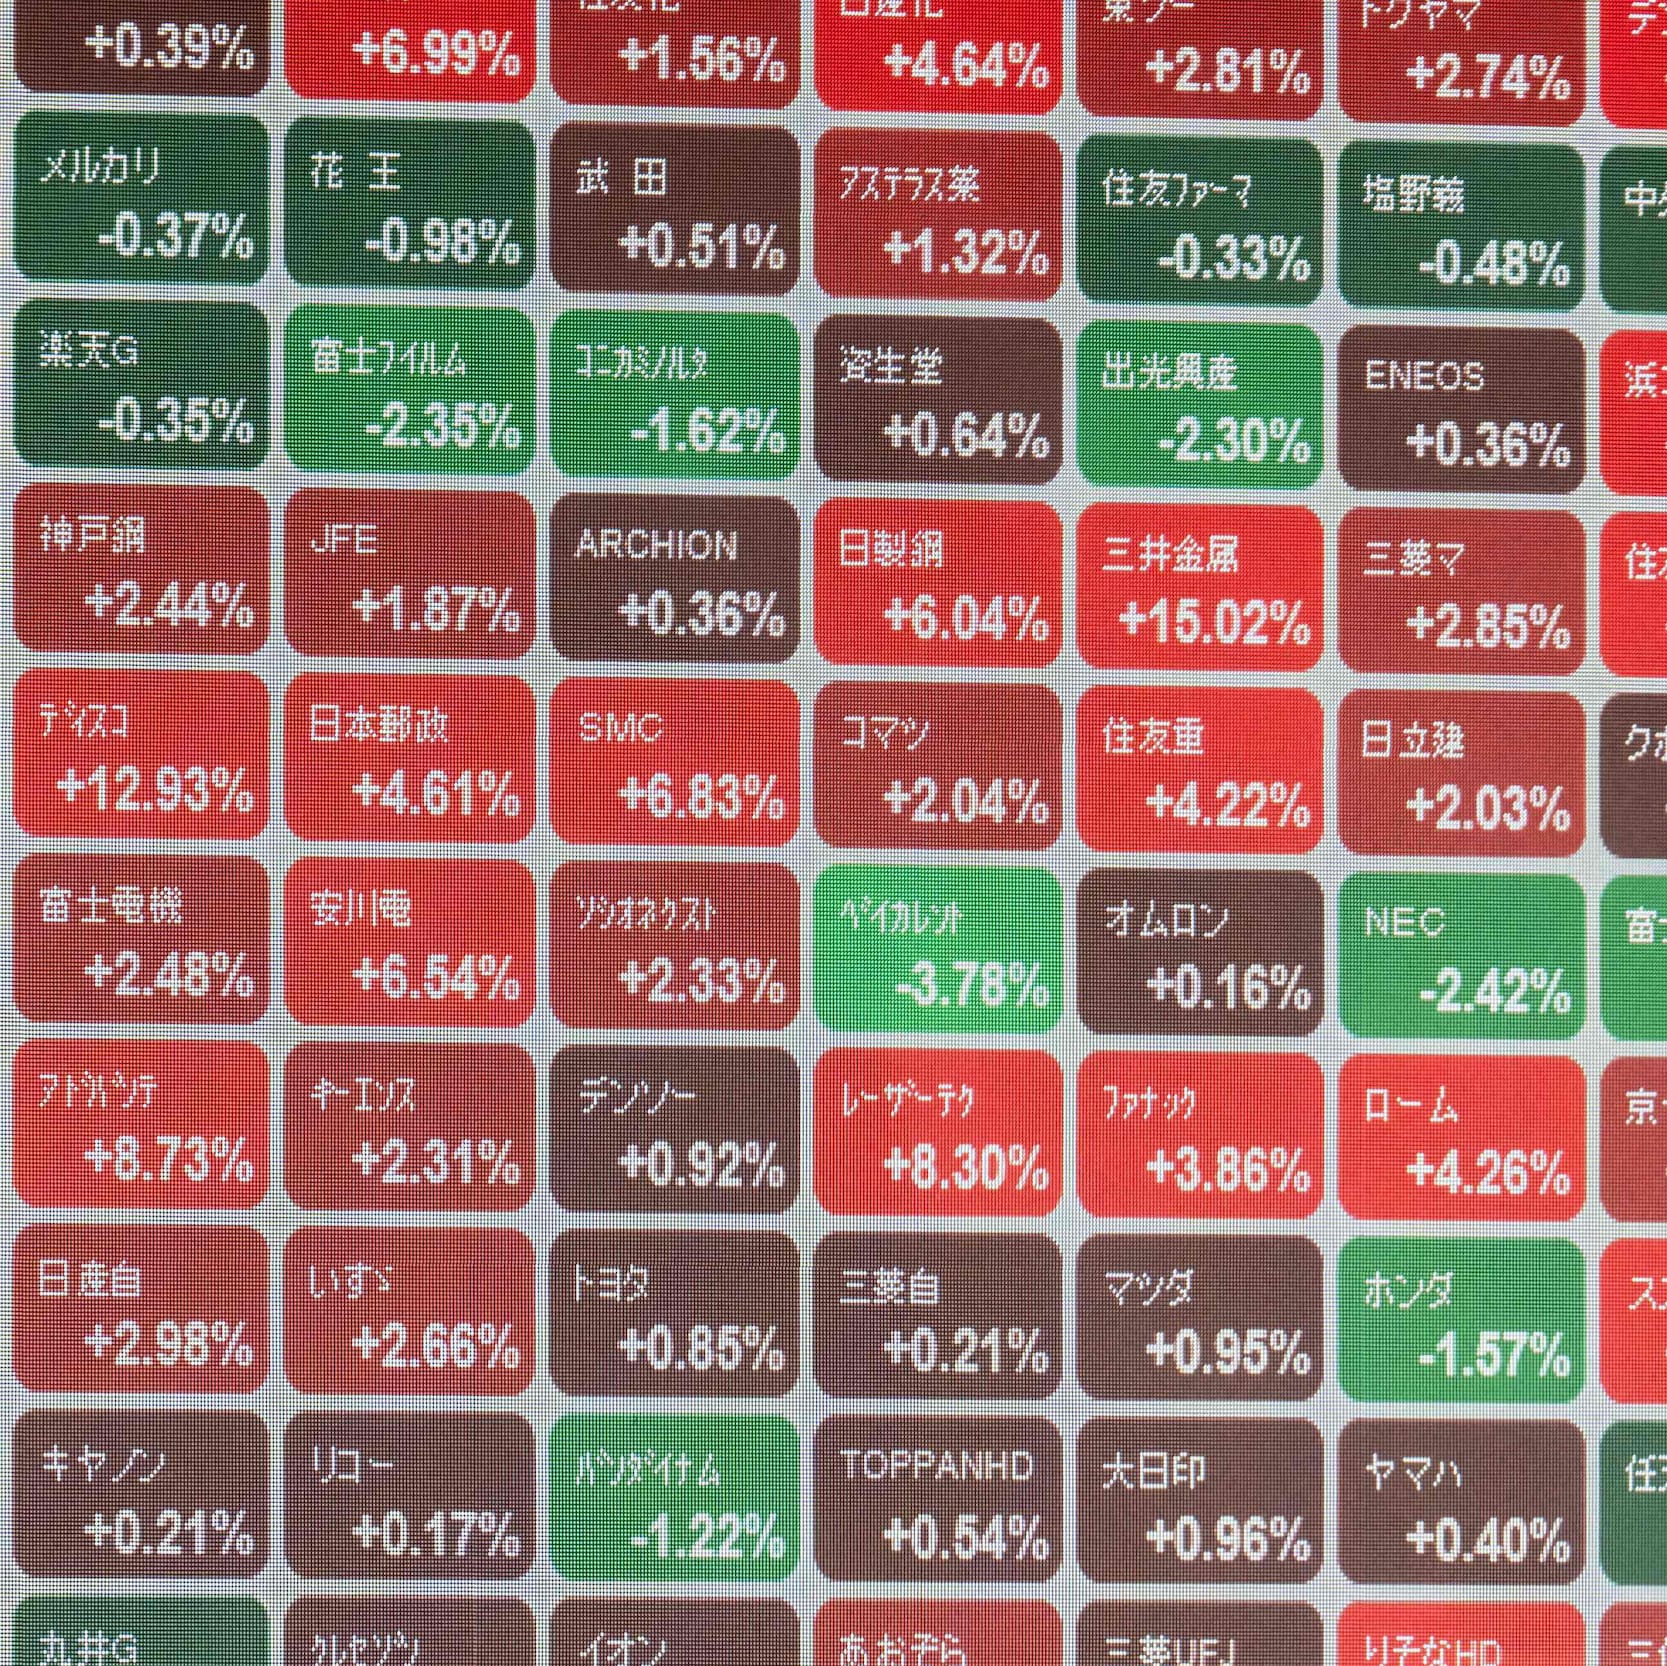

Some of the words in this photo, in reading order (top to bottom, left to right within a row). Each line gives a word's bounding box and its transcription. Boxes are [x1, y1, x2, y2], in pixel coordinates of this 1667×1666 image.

[84, 20, 256, 71] +0.39%
[352, 27, 522, 77] +6.99%
[618, 34, 787, 83] +1.56%
[883, 40, 1051, 89] +4.64%
[1145, 45, 1312, 96] +2.81%
[1405, 51, 1572, 101] +2.74%
[39, 147, 160, 185] メルカリ
[97, 209, 255, 261] -0.37%
[364, 215, 522, 266] -0.98%
[618, 220, 787, 271] +0.51%
[883, 227, 1050, 276] +1.32%
[1157, 232, 1312, 283] -0.33%
[1418, 238, 1571, 288] -0.48%
[39, 330, 139, 368] 楽天G
[1363, 358, 1486, 392] ENEOS
[97, 395, 255, 445] -0.35%
[364, 400, 521, 450] -2.35%
[630, 405, 787, 455] -1.62%
[883, 409, 1051, 460] +0.64%
[1158, 414, 1312, 465] -2.30%
[1406, 419, 1572, 469] +0.36%
[309, 522, 377, 555] JFE
[574, 527, 739, 561] ARCHION
[84, 579, 255, 629] +2.44%
[352, 584, 522, 634] +1.87%
[618, 588, 787, 638] +0.36%
[883, 592, 1051, 642] +6.04%
[1118, 597, 1312, 646] +15.02%
[1406, 601, 1572, 650] +2.85%
[308, 703, 449, 744] 日本郵政
[577, 711, 661, 743] SMC
[842, 714, 930, 751] コマツ
[56, 763, 255, 814] +12.93%
[352, 768, 521, 818] +4.61%
[618, 771, 786, 821] +6.83%
[883, 775, 1051, 825] +2.04%
[1145, 780, 1312, 829] +4.22%
[1406, 782, 1572, 832] +2.03%
[1105, 901, 1230, 938] オムロン
[1362, 906, 1444, 938] NEC
[84, 949, 255, 998] +2.48%
[352, 952, 521, 1002] +6.54%
[618, 955, 787, 1004] +2.33%
[895, 959, 1051, 1009] -3.78%
[1146, 962, 1313, 1011] +0.16%
[1419, 965, 1572, 1015] -2.42%
[1363, 1087, 1460, 1124] ローム
[83, 1133, 255, 1184] +8.73%
[351, 1136, 522, 1186] +2.31%
[617, 1139, 786, 1189] +0.92%
[883, 1141, 1051, 1191] +8.30%
[1145, 1144, 1312, 1194] +3.86%
[1406, 1147, 1572, 1196] +4.26%
[572, 1265, 650, 1301] トヨタ
[1104, 1268, 1195, 1306] マツダ
[1362, 1271, 1454, 1310] ホンダ
[83, 1318, 255, 1368] +2.98%
[351, 1320, 522, 1370] +2.66%
[617, 1323, 786, 1372] +0.85%
[882, 1325, 1050, 1375] +0.21%
[1145, 1327, 1313, 1376] +0.95%
[1418, 1329, 1572, 1379] -1.57%
[310, 1447, 394, 1483] リコー
[839, 1448, 1035, 1482] TOPPANHD
[83, 1507, 255, 1557] +0.21%
[351, 1509, 521, 1558] +0.17%
[630, 1511, 786, 1561] -1.22%
[882, 1512, 1051, 1561] +0.54%
[1145, 1514, 1313, 1563] +0.96%
[1405, 1515, 1572, 1564] +0.40%
